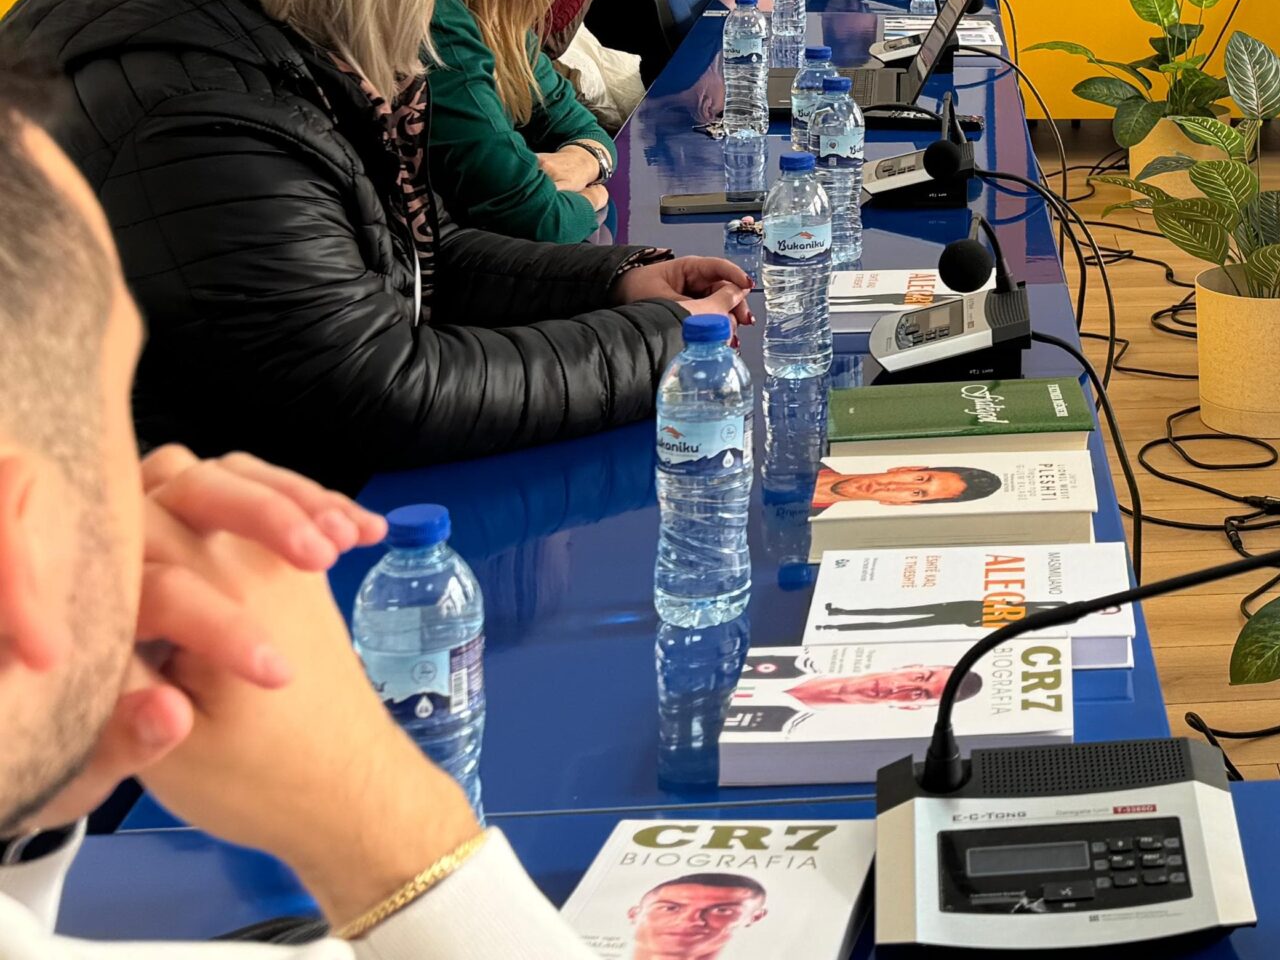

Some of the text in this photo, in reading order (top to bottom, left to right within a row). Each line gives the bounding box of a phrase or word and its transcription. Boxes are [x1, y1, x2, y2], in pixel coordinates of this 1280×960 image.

[776, 239, 825, 251] Bukaniku
[1038, 463, 1057, 501] PLESHTI
[982, 553, 1026, 629] ALEGRI
[991, 647, 1013, 717] BIOGRAFIA
[1020, 645, 1063, 713] CR7
[632, 825, 838, 851] CR7
[619, 852, 818, 870] BIOGRAFIA
